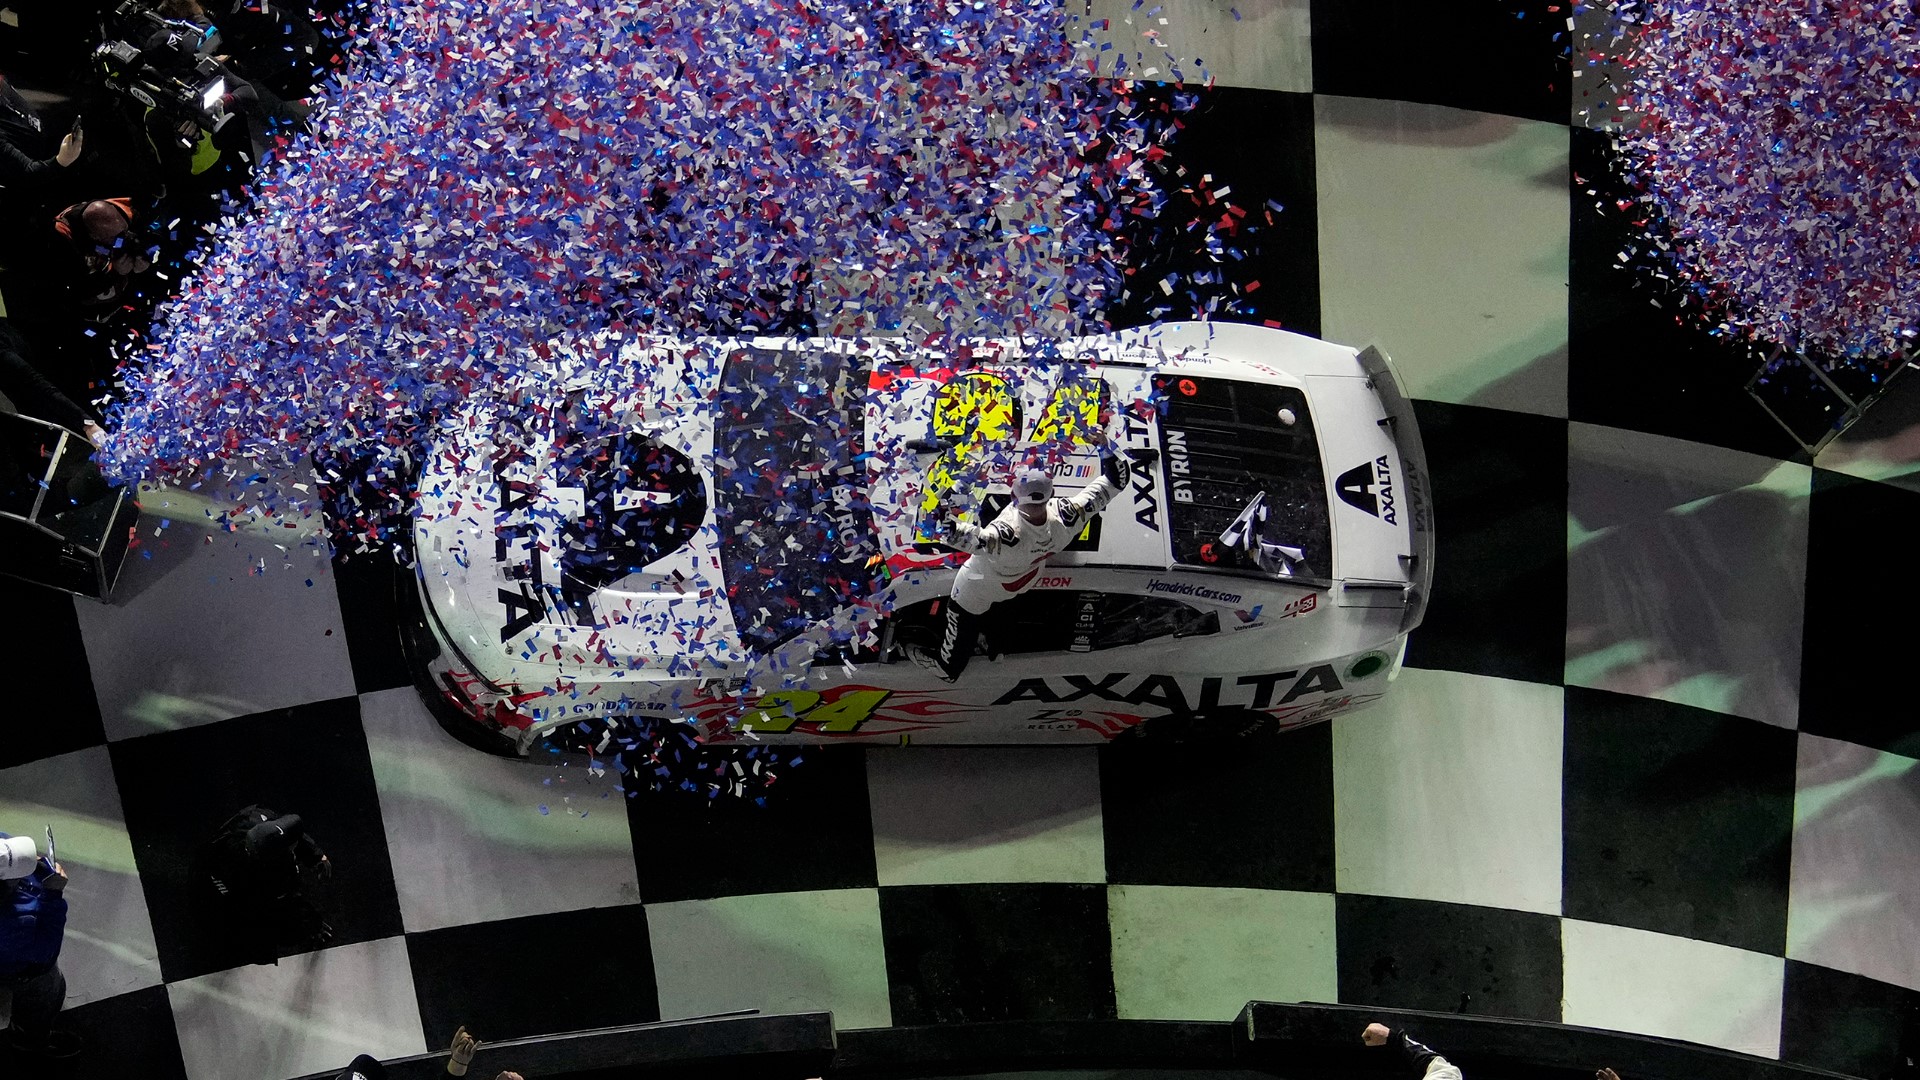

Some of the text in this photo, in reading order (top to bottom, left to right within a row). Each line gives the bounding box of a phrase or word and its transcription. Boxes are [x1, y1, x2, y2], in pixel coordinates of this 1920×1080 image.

[1166, 429, 1194, 503] BYRON
[1376, 454, 1398, 527] AXALTA
[730, 689, 894, 735] 24
[990, 663, 1344, 714] AXALTA
